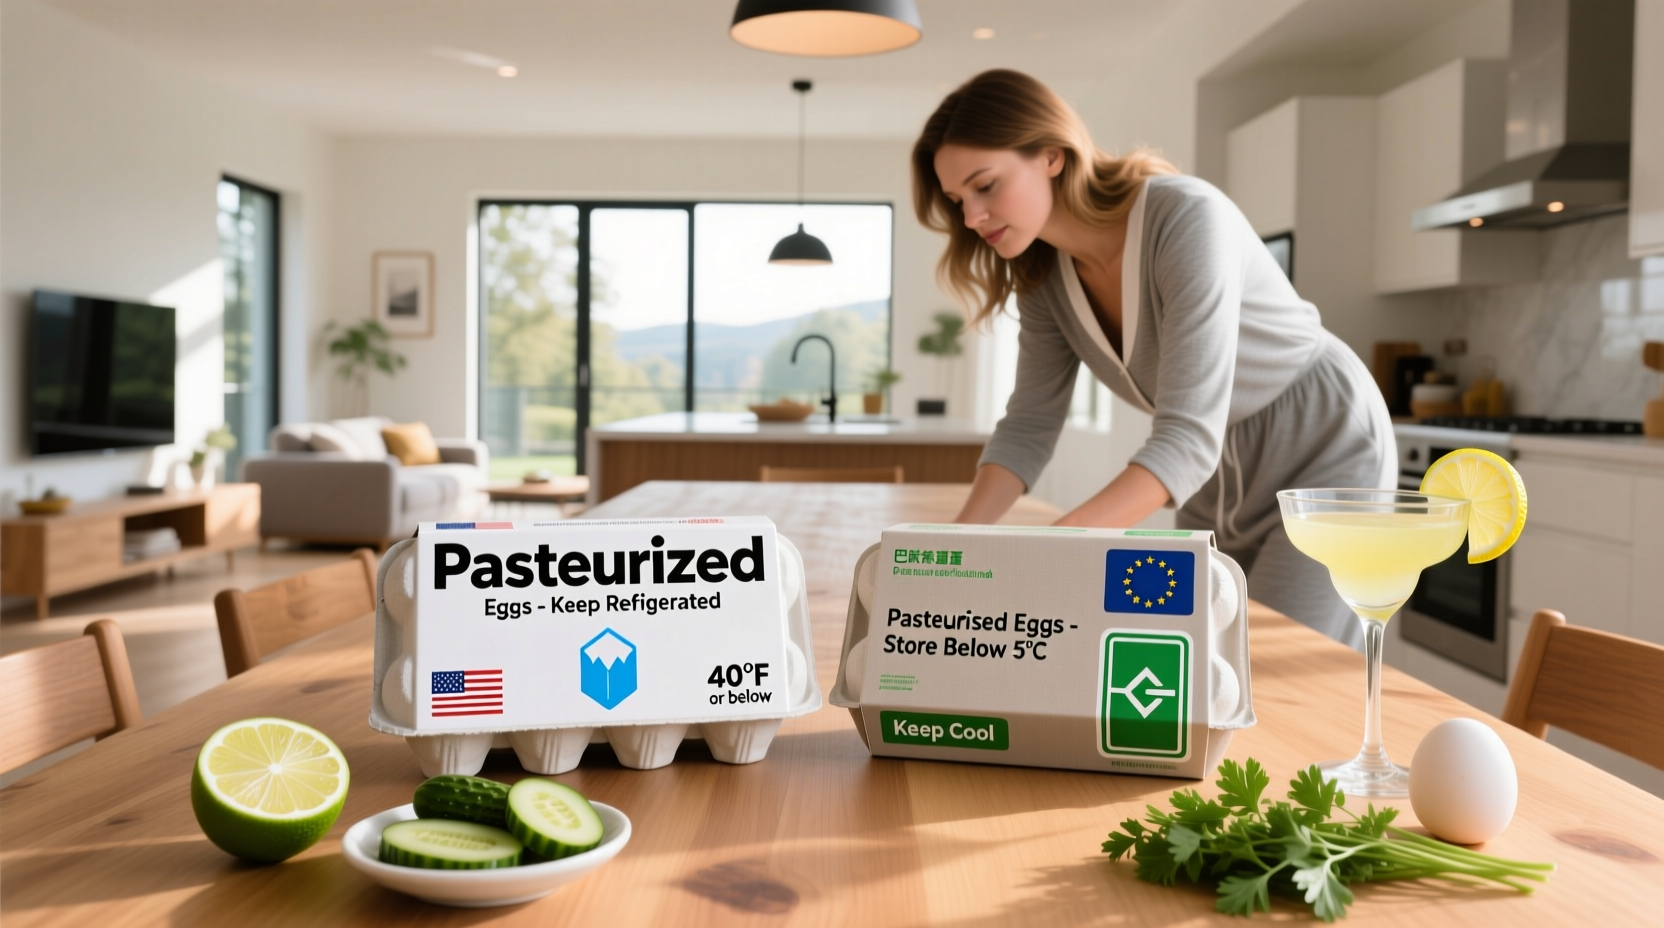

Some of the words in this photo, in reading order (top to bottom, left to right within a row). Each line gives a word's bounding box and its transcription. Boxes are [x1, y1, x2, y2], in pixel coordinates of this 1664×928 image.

[434, 535, 764, 589] Pasteurized
[485, 599, 532, 620] Eggs
[552, 596, 600, 616] Keep
[607, 592, 720, 615] Refigerated
[888, 608, 1007, 631] Pasteurised
[1014, 613, 1063, 638] Eggs
[884, 635, 937, 655] Store
[944, 637, 1007, 658] Below
[709, 694, 725, 705] or
[729, 689, 772, 704] below
[894, 720, 943, 742] Keep
[950, 723, 994, 741] Cool
